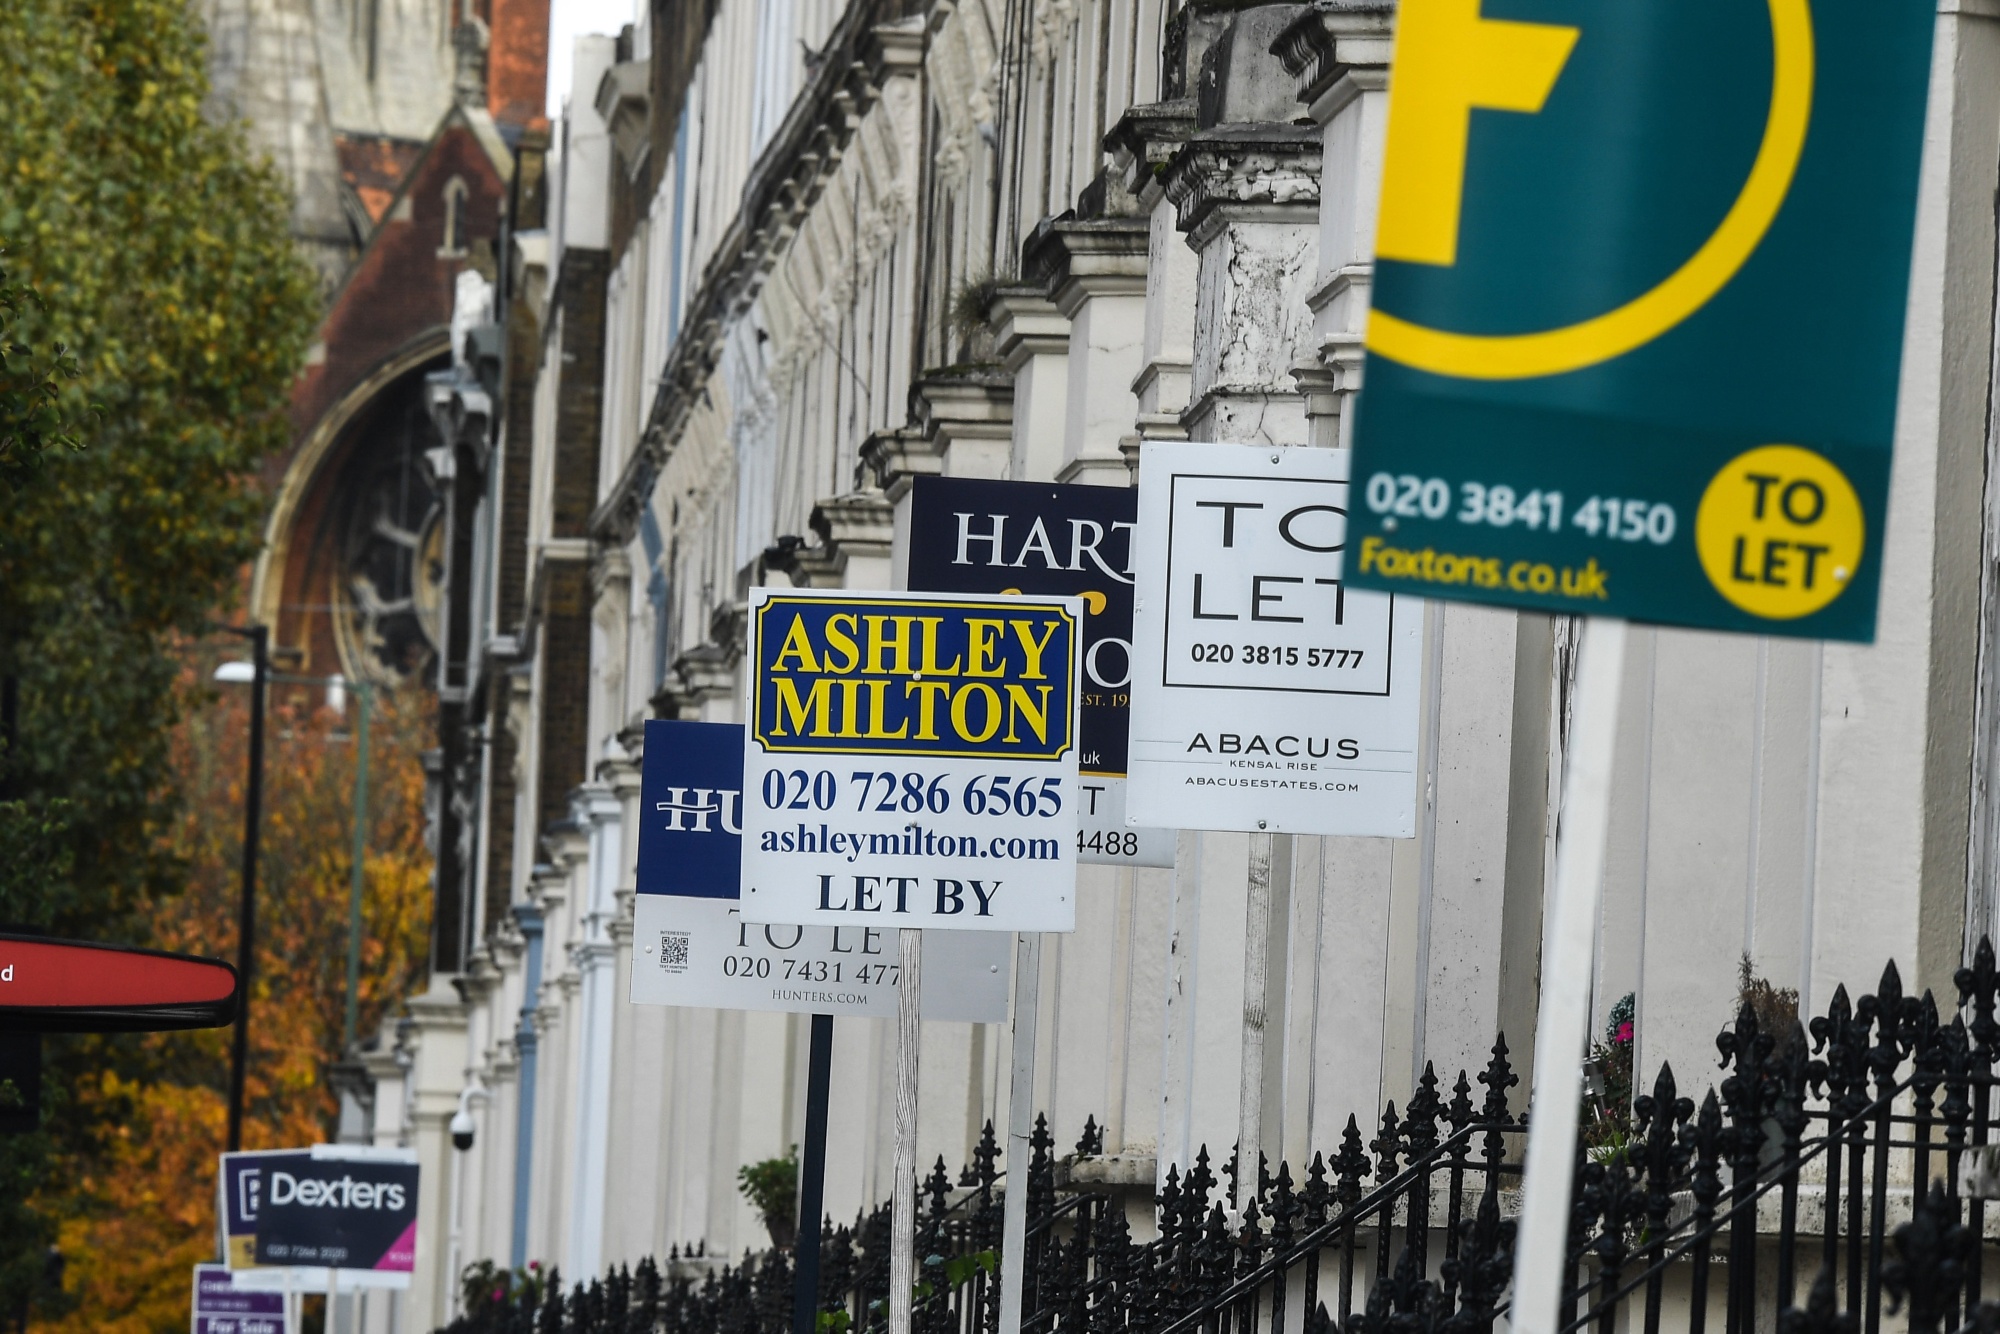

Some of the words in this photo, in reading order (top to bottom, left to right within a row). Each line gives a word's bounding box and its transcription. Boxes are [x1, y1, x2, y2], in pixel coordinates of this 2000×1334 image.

[1365, 472, 1450, 520] 020
[1457, 482, 1563, 532] 3841
[1571, 495, 1677, 545] 4150
[1743, 471, 1827, 527] TO
[1196, 501, 1347, 553] TO
[1359, 536, 1608, 600] Foxtons.co.uk
[1731, 533, 1832, 592] LET
[1193, 573, 1345, 625] LET
[770, 612, 1061, 680] ASHLEY
[1191, 643, 1234, 664] 020
[1241, 645, 1299, 666] 3815
[1307, 648, 1364, 669] 5777
[769, 677, 1054, 746] MILTON
[1111, 693, 1131, 708] 19
[1186, 732, 1360, 760] ABACUS
[1229, 760, 1282, 770] KENSAL
[1287, 762, 1318, 771] RISE
[762, 769, 837, 811] 020
[850, 771, 950, 815] 7286
[963, 774, 1062, 818] 6565
[1078, 785, 1105, 815] T
[1185, 777, 1359, 792] ABACUSESTATES.COM
[760, 823, 1060, 863] ashleymilton.com
[815, 874, 919, 914] LET
[932, 878, 1003, 917] BY
[723, 955, 771, 979] 020
[782, 959, 843, 983] 7431
[772, 989, 868, 1005] HUNTERS.COM
[270, 1171, 406, 1211] Dexters
